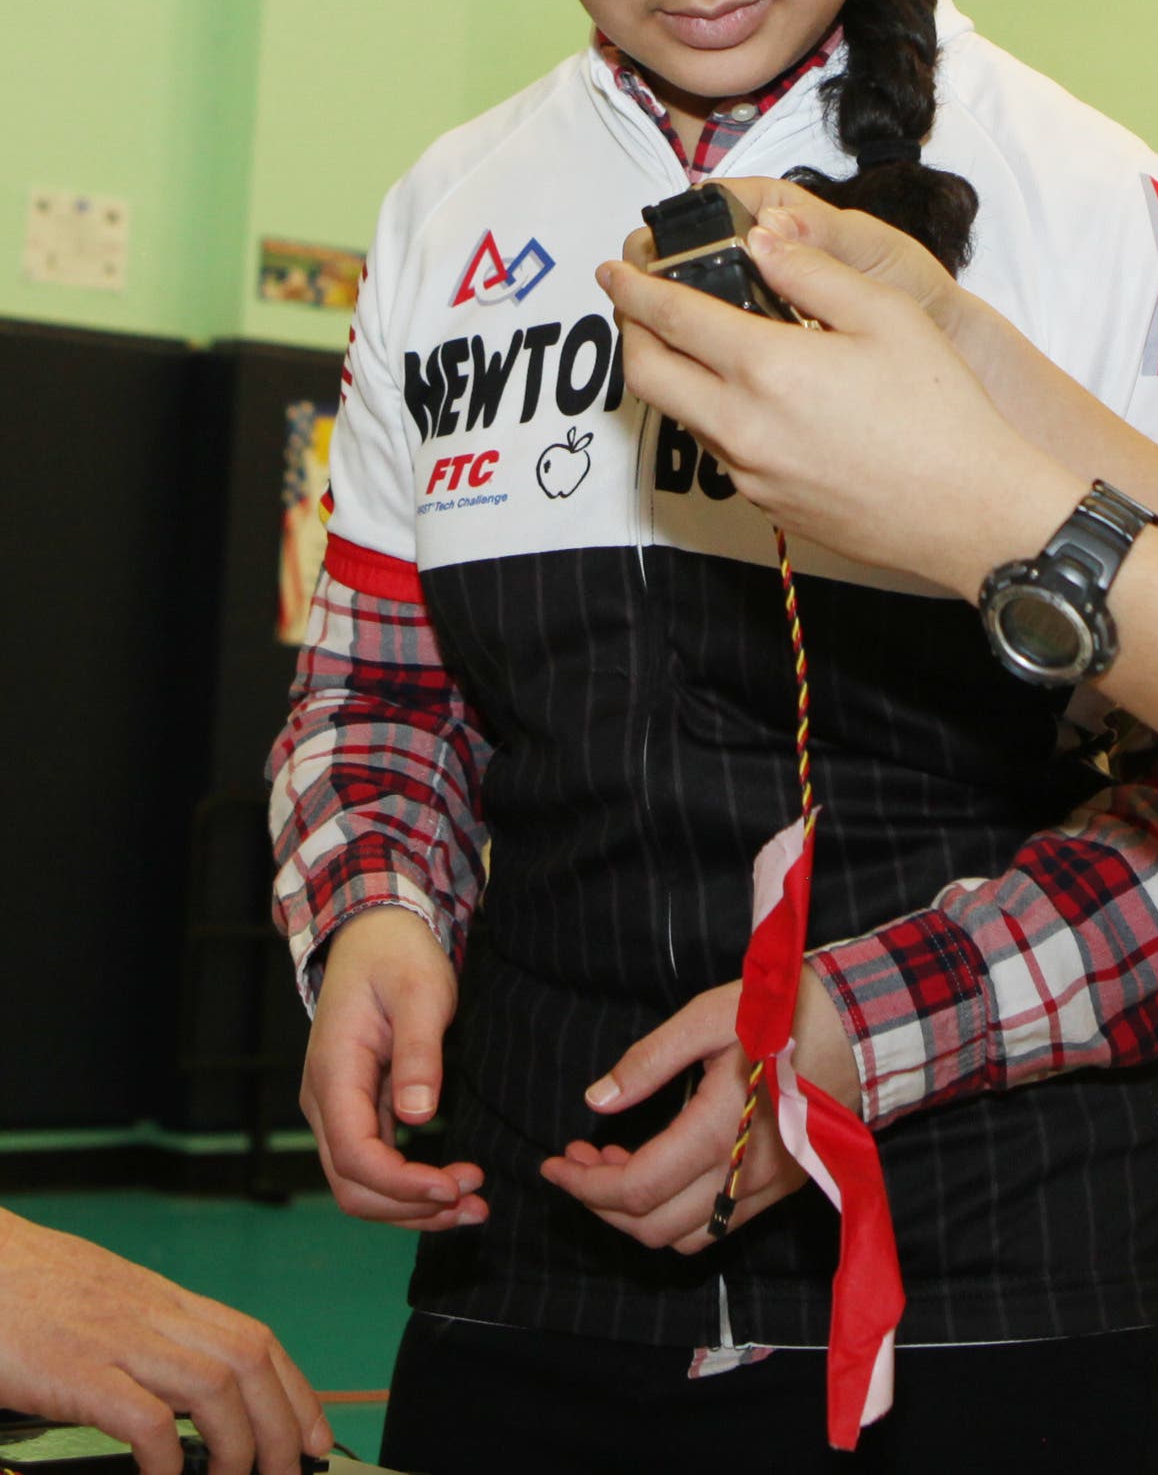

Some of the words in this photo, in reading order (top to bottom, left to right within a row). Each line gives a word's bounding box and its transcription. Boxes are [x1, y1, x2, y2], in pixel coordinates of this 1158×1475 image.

[425, 450, 500, 495] FTC
[435, 500, 455, 512] Tech
[457, 493, 509, 509] Challenge
